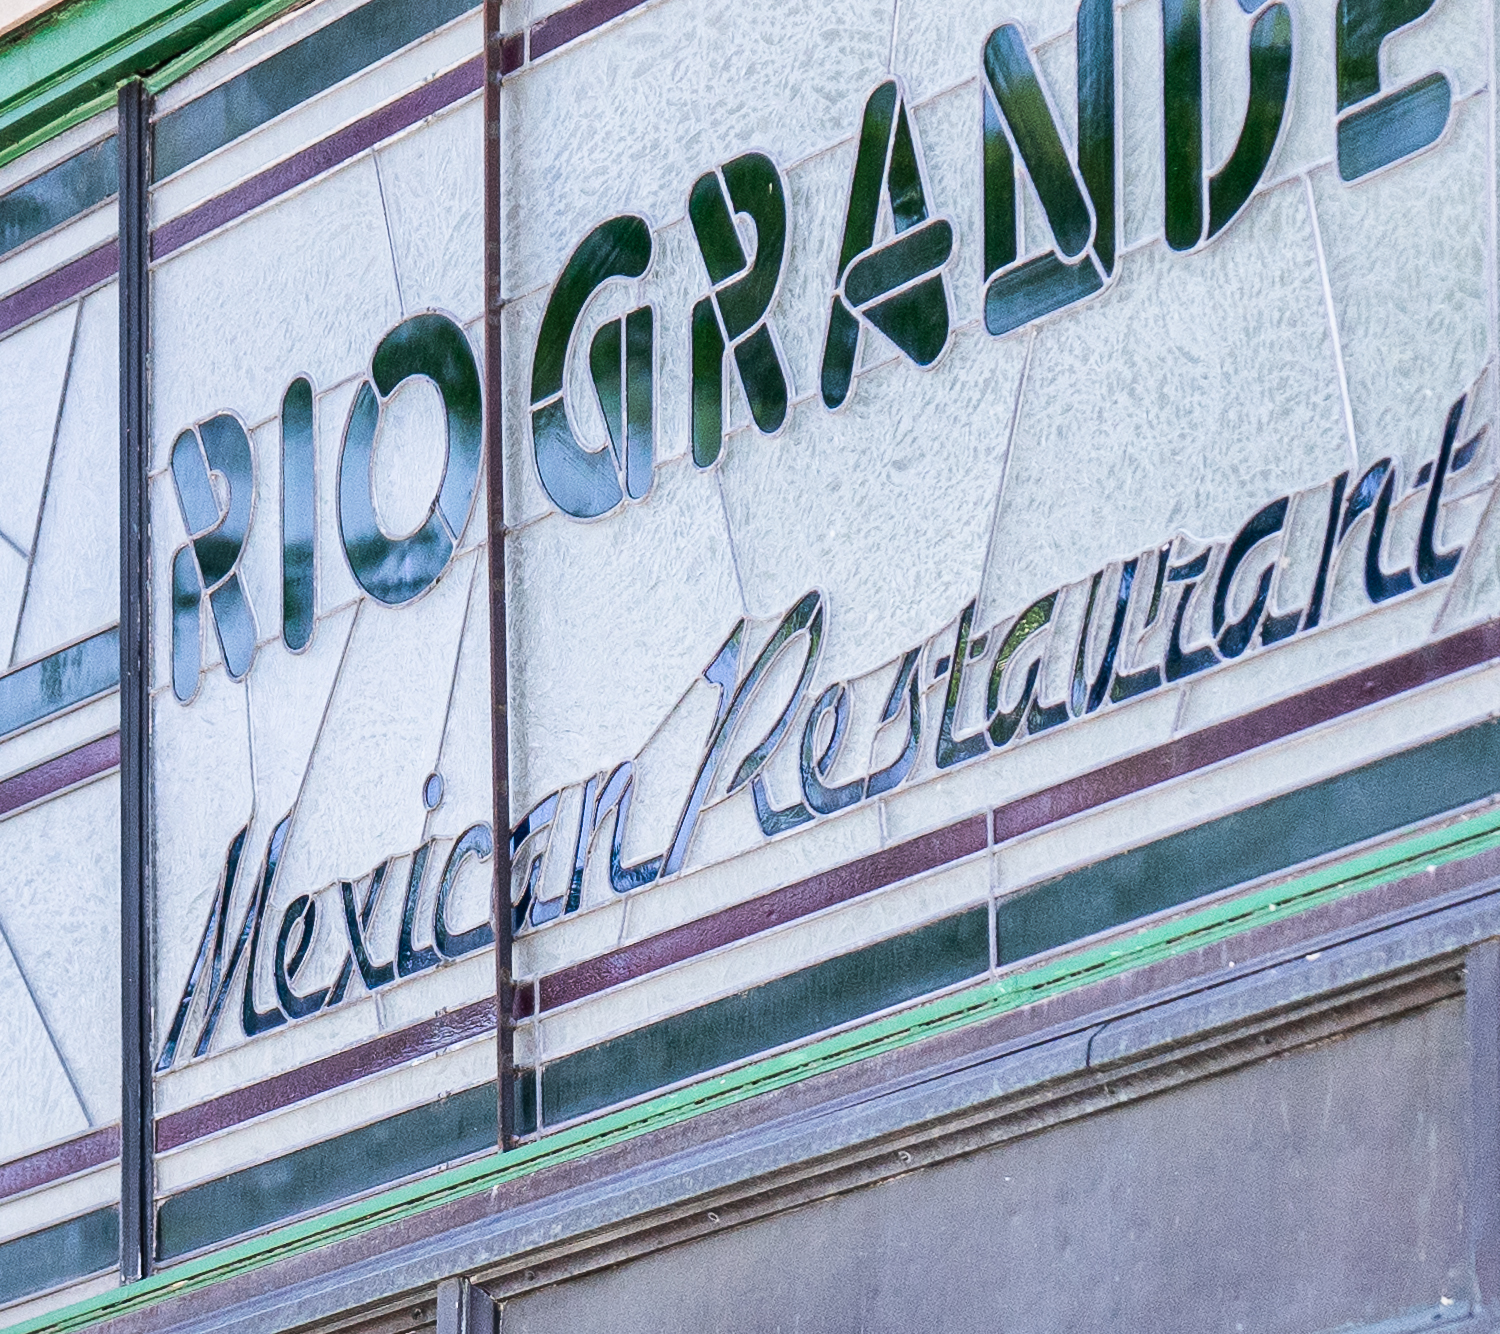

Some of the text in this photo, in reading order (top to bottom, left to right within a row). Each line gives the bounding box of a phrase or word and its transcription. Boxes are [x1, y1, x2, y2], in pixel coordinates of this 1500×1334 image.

[156, 391, 1491, 1071] Mexican Restaurant
[171, 312, 483, 704] RIO
